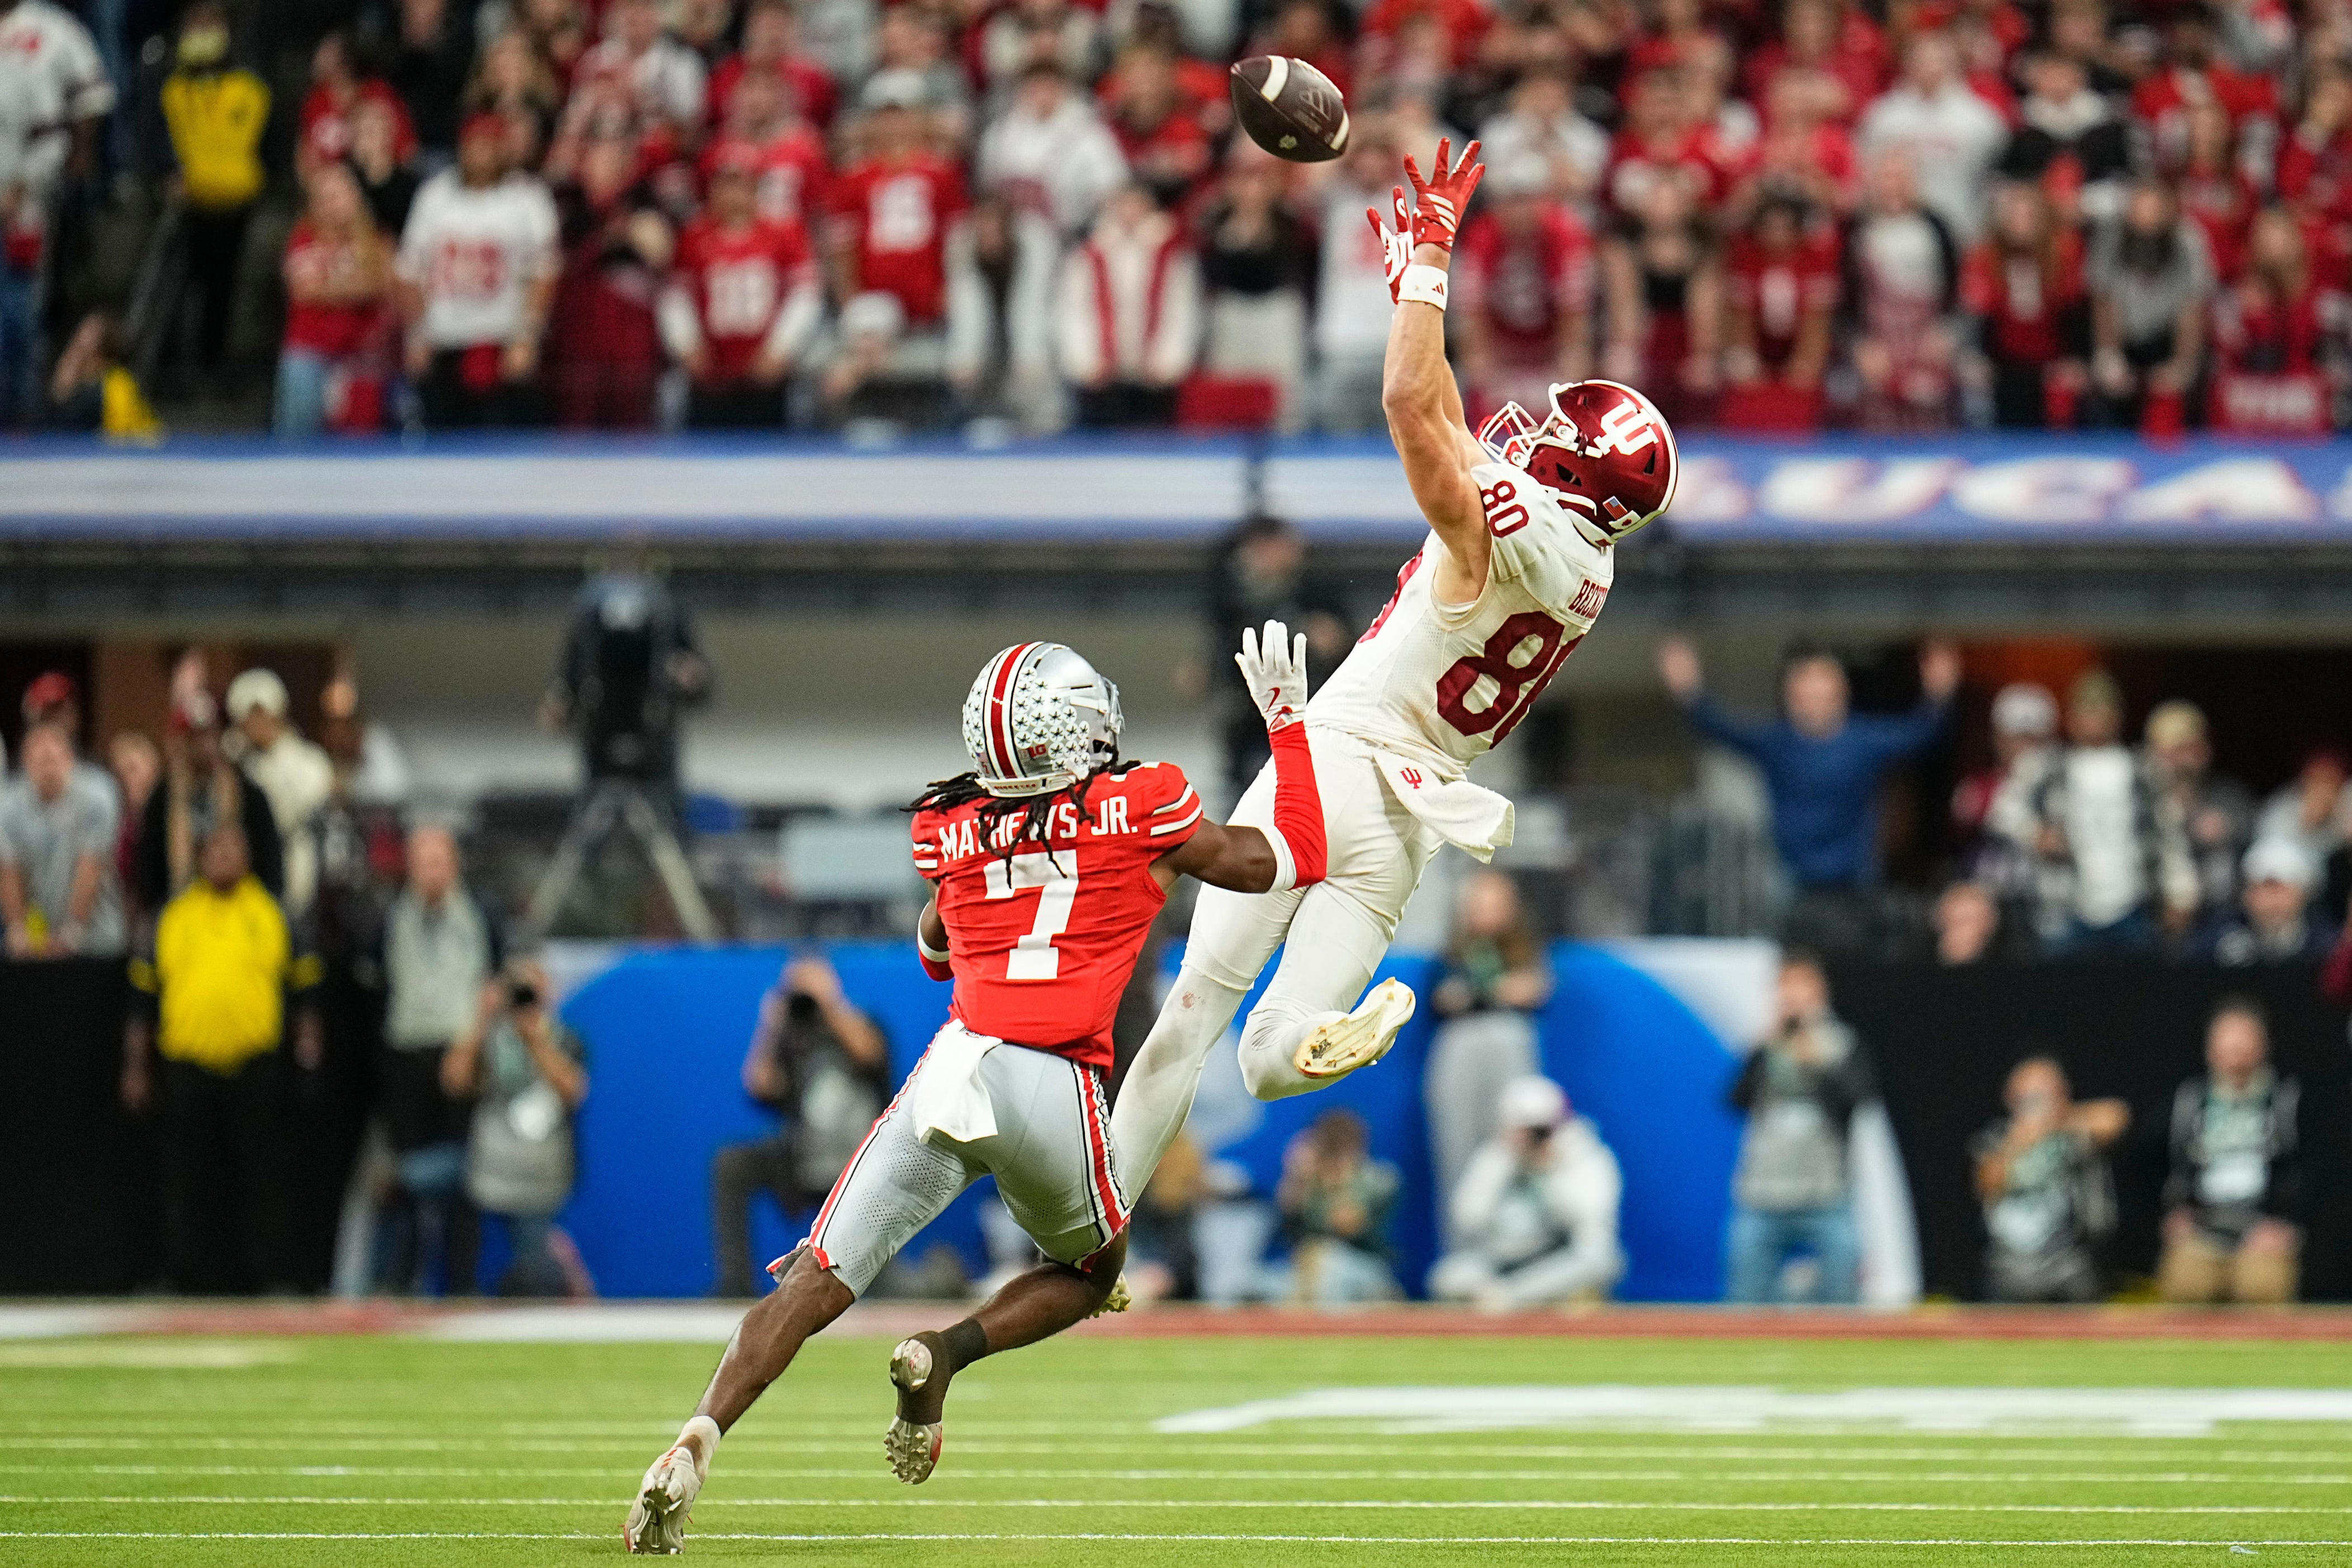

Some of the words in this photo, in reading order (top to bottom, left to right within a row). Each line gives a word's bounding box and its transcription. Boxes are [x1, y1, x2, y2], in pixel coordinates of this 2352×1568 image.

[1480, 480, 1529, 538] 80
[1672, 452, 2352, 525] UCA
[1090, 795, 1139, 836] JR.
[983, 849, 1079, 980] 7
